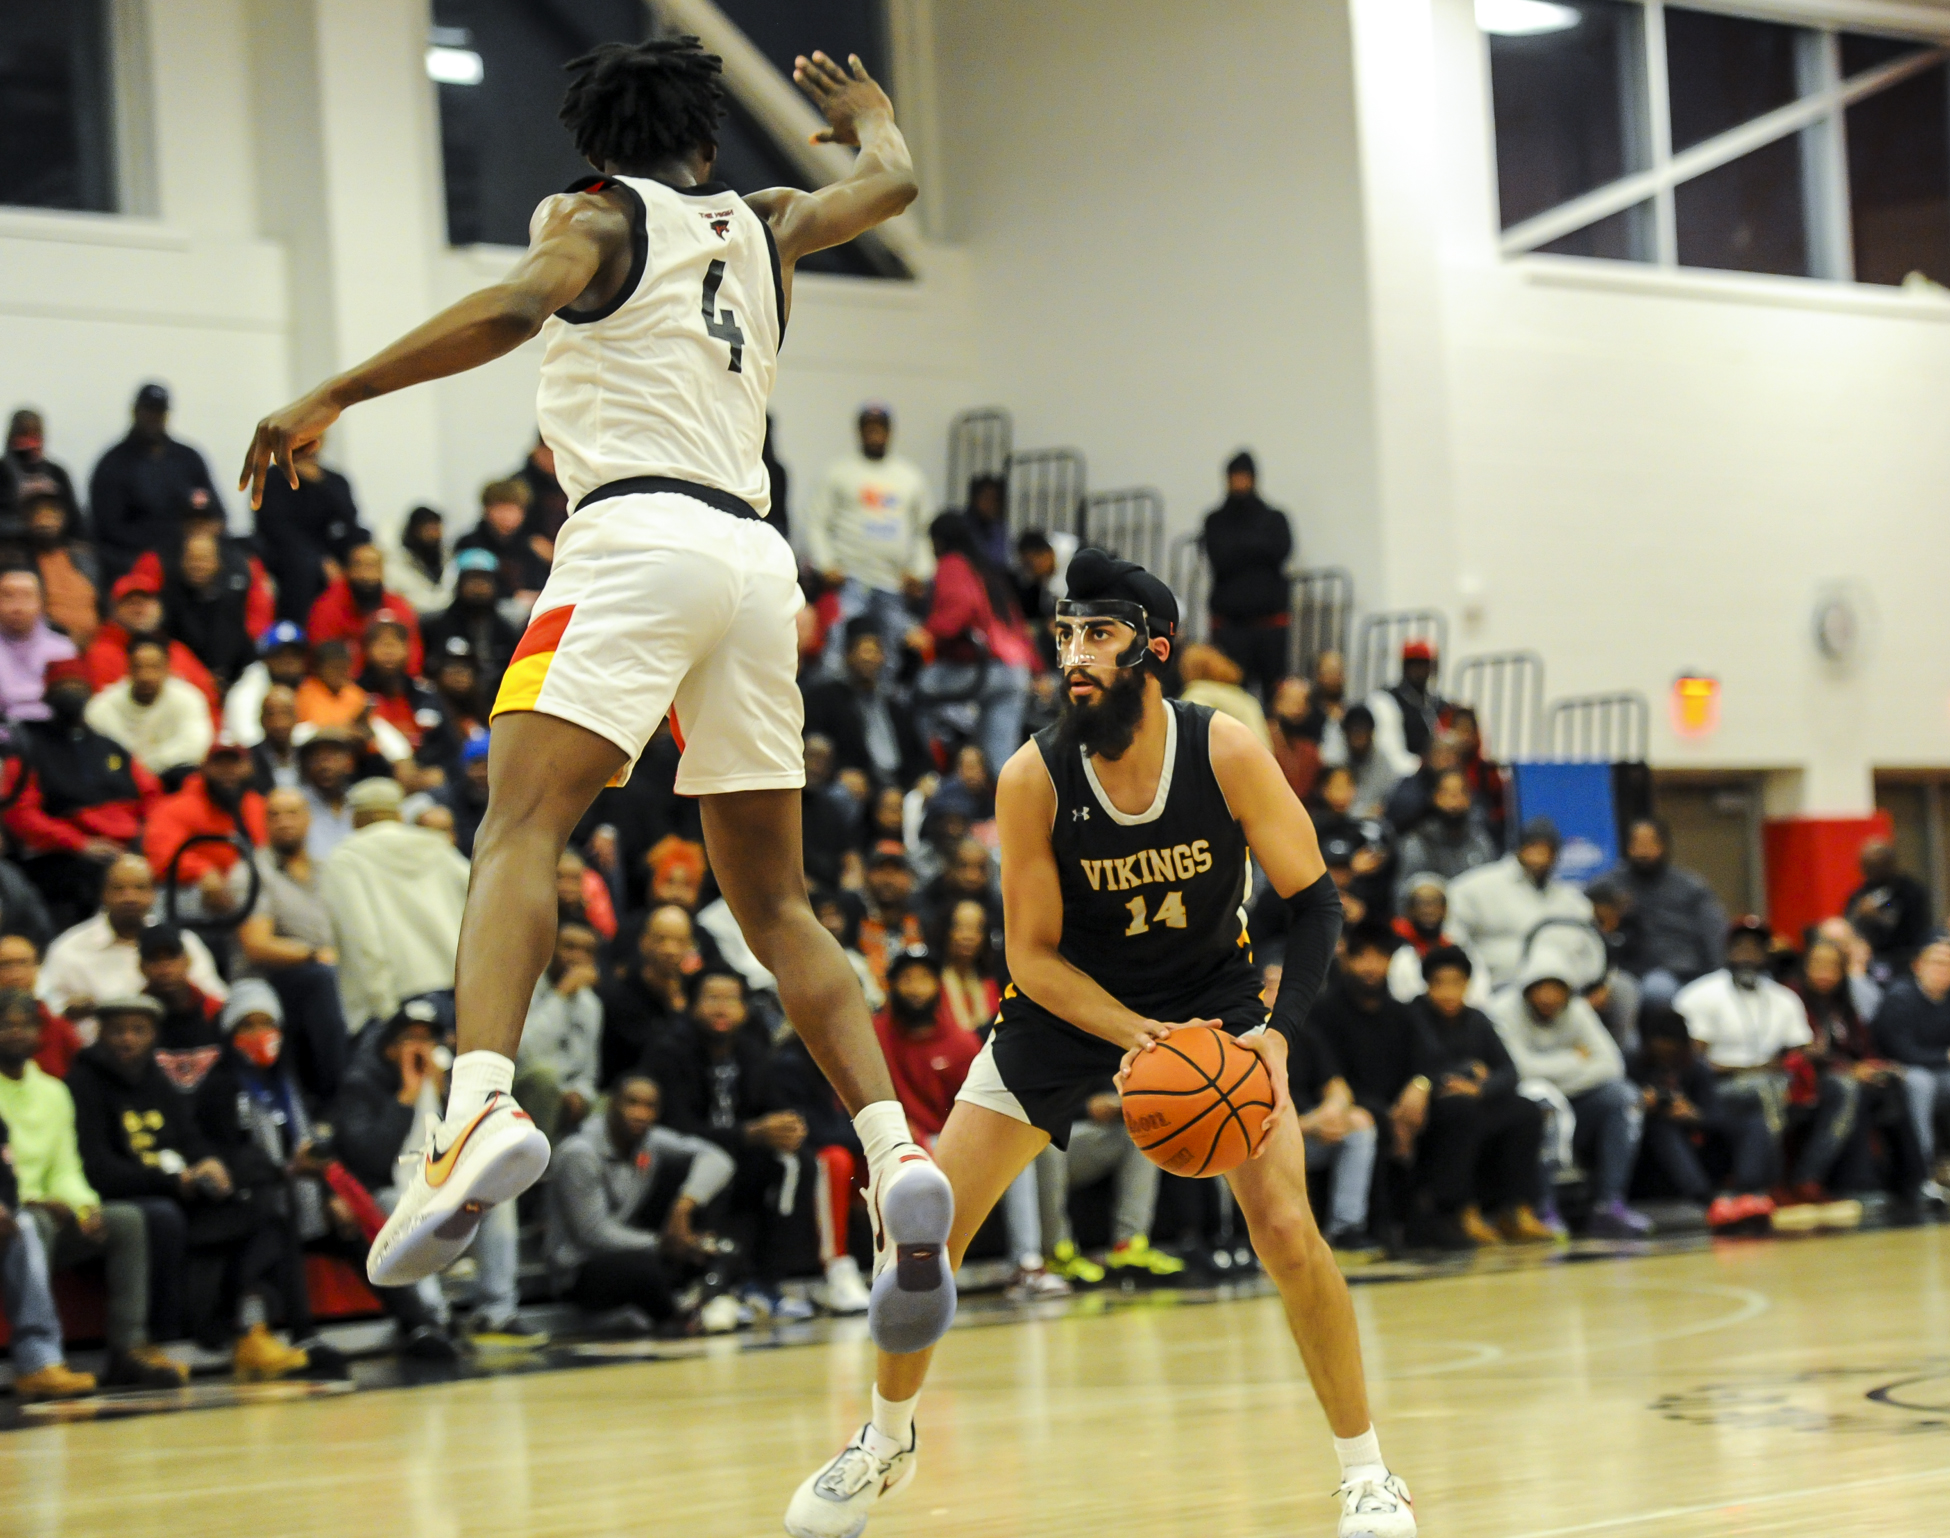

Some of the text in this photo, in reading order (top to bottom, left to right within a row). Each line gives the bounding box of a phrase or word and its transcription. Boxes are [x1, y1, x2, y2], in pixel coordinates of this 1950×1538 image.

[701, 258, 746, 374] 4
[1080, 839, 1213, 891] VIKINGS
[1124, 890, 1188, 937] 14
